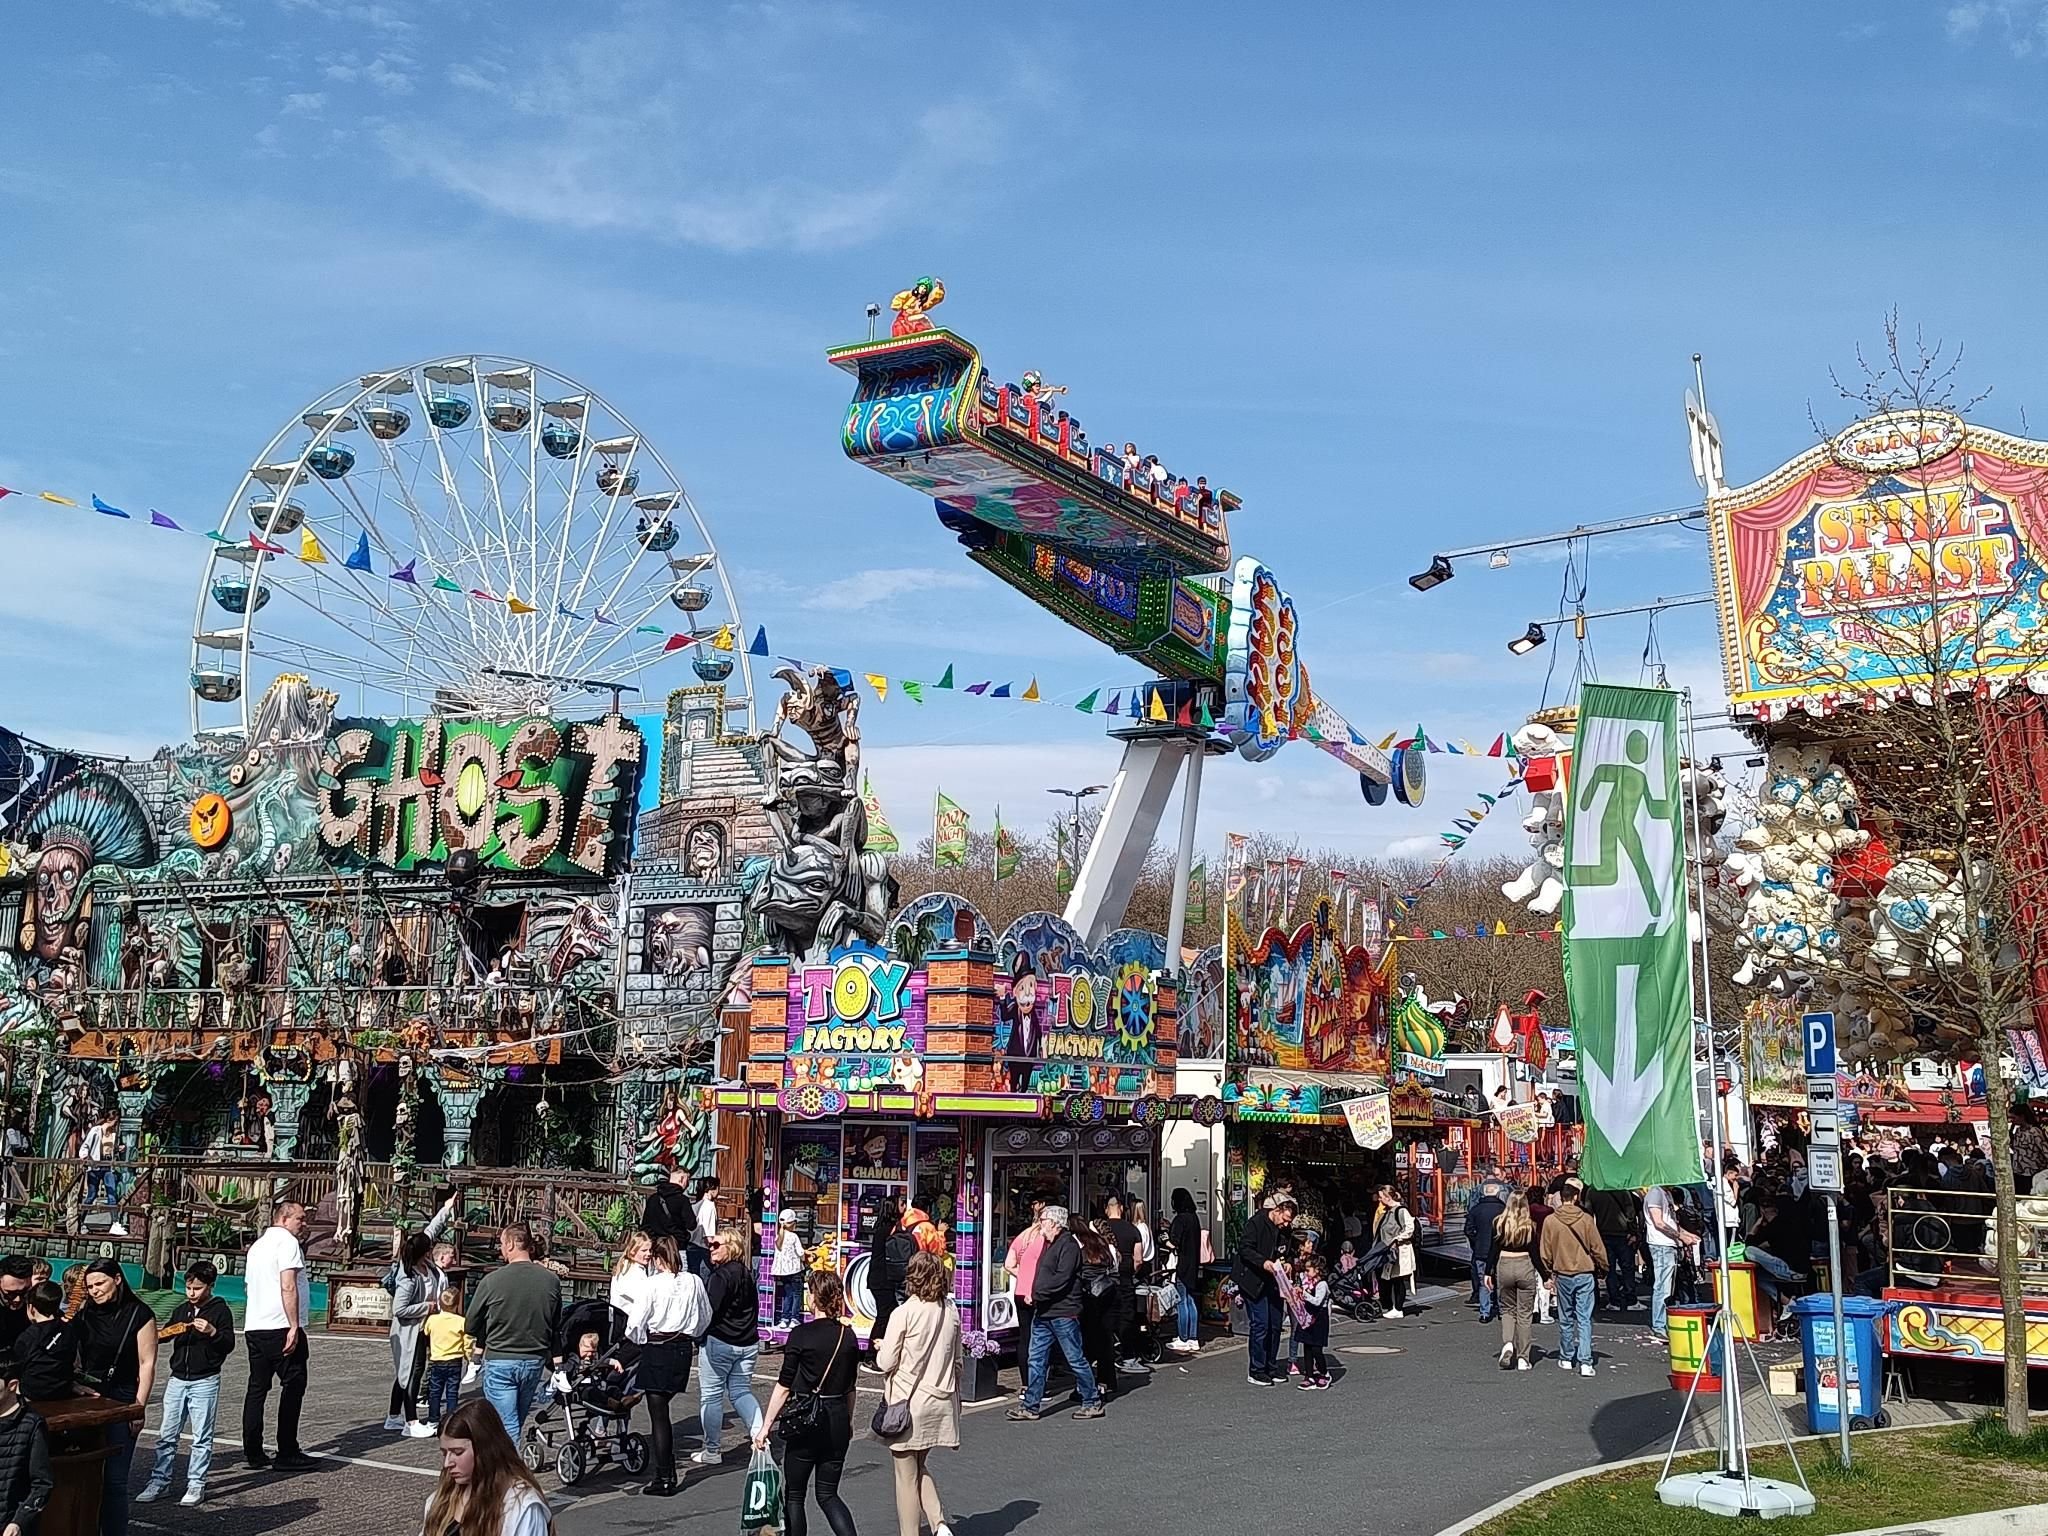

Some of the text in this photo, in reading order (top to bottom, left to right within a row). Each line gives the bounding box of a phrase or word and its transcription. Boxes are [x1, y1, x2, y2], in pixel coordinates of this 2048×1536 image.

[317, 712, 642, 876] GHOST
[801, 961, 912, 1020] TOY
[1052, 973, 1112, 1030] TOY
[802, 1025, 906, 1053] FACTORY
[1047, 1032, 1105, 1058] FACTORY
[1809, 1022, 1826, 1067] P
[1410, 1055, 1444, 1074] NACHT
[750, 1481, 766, 1510] D
